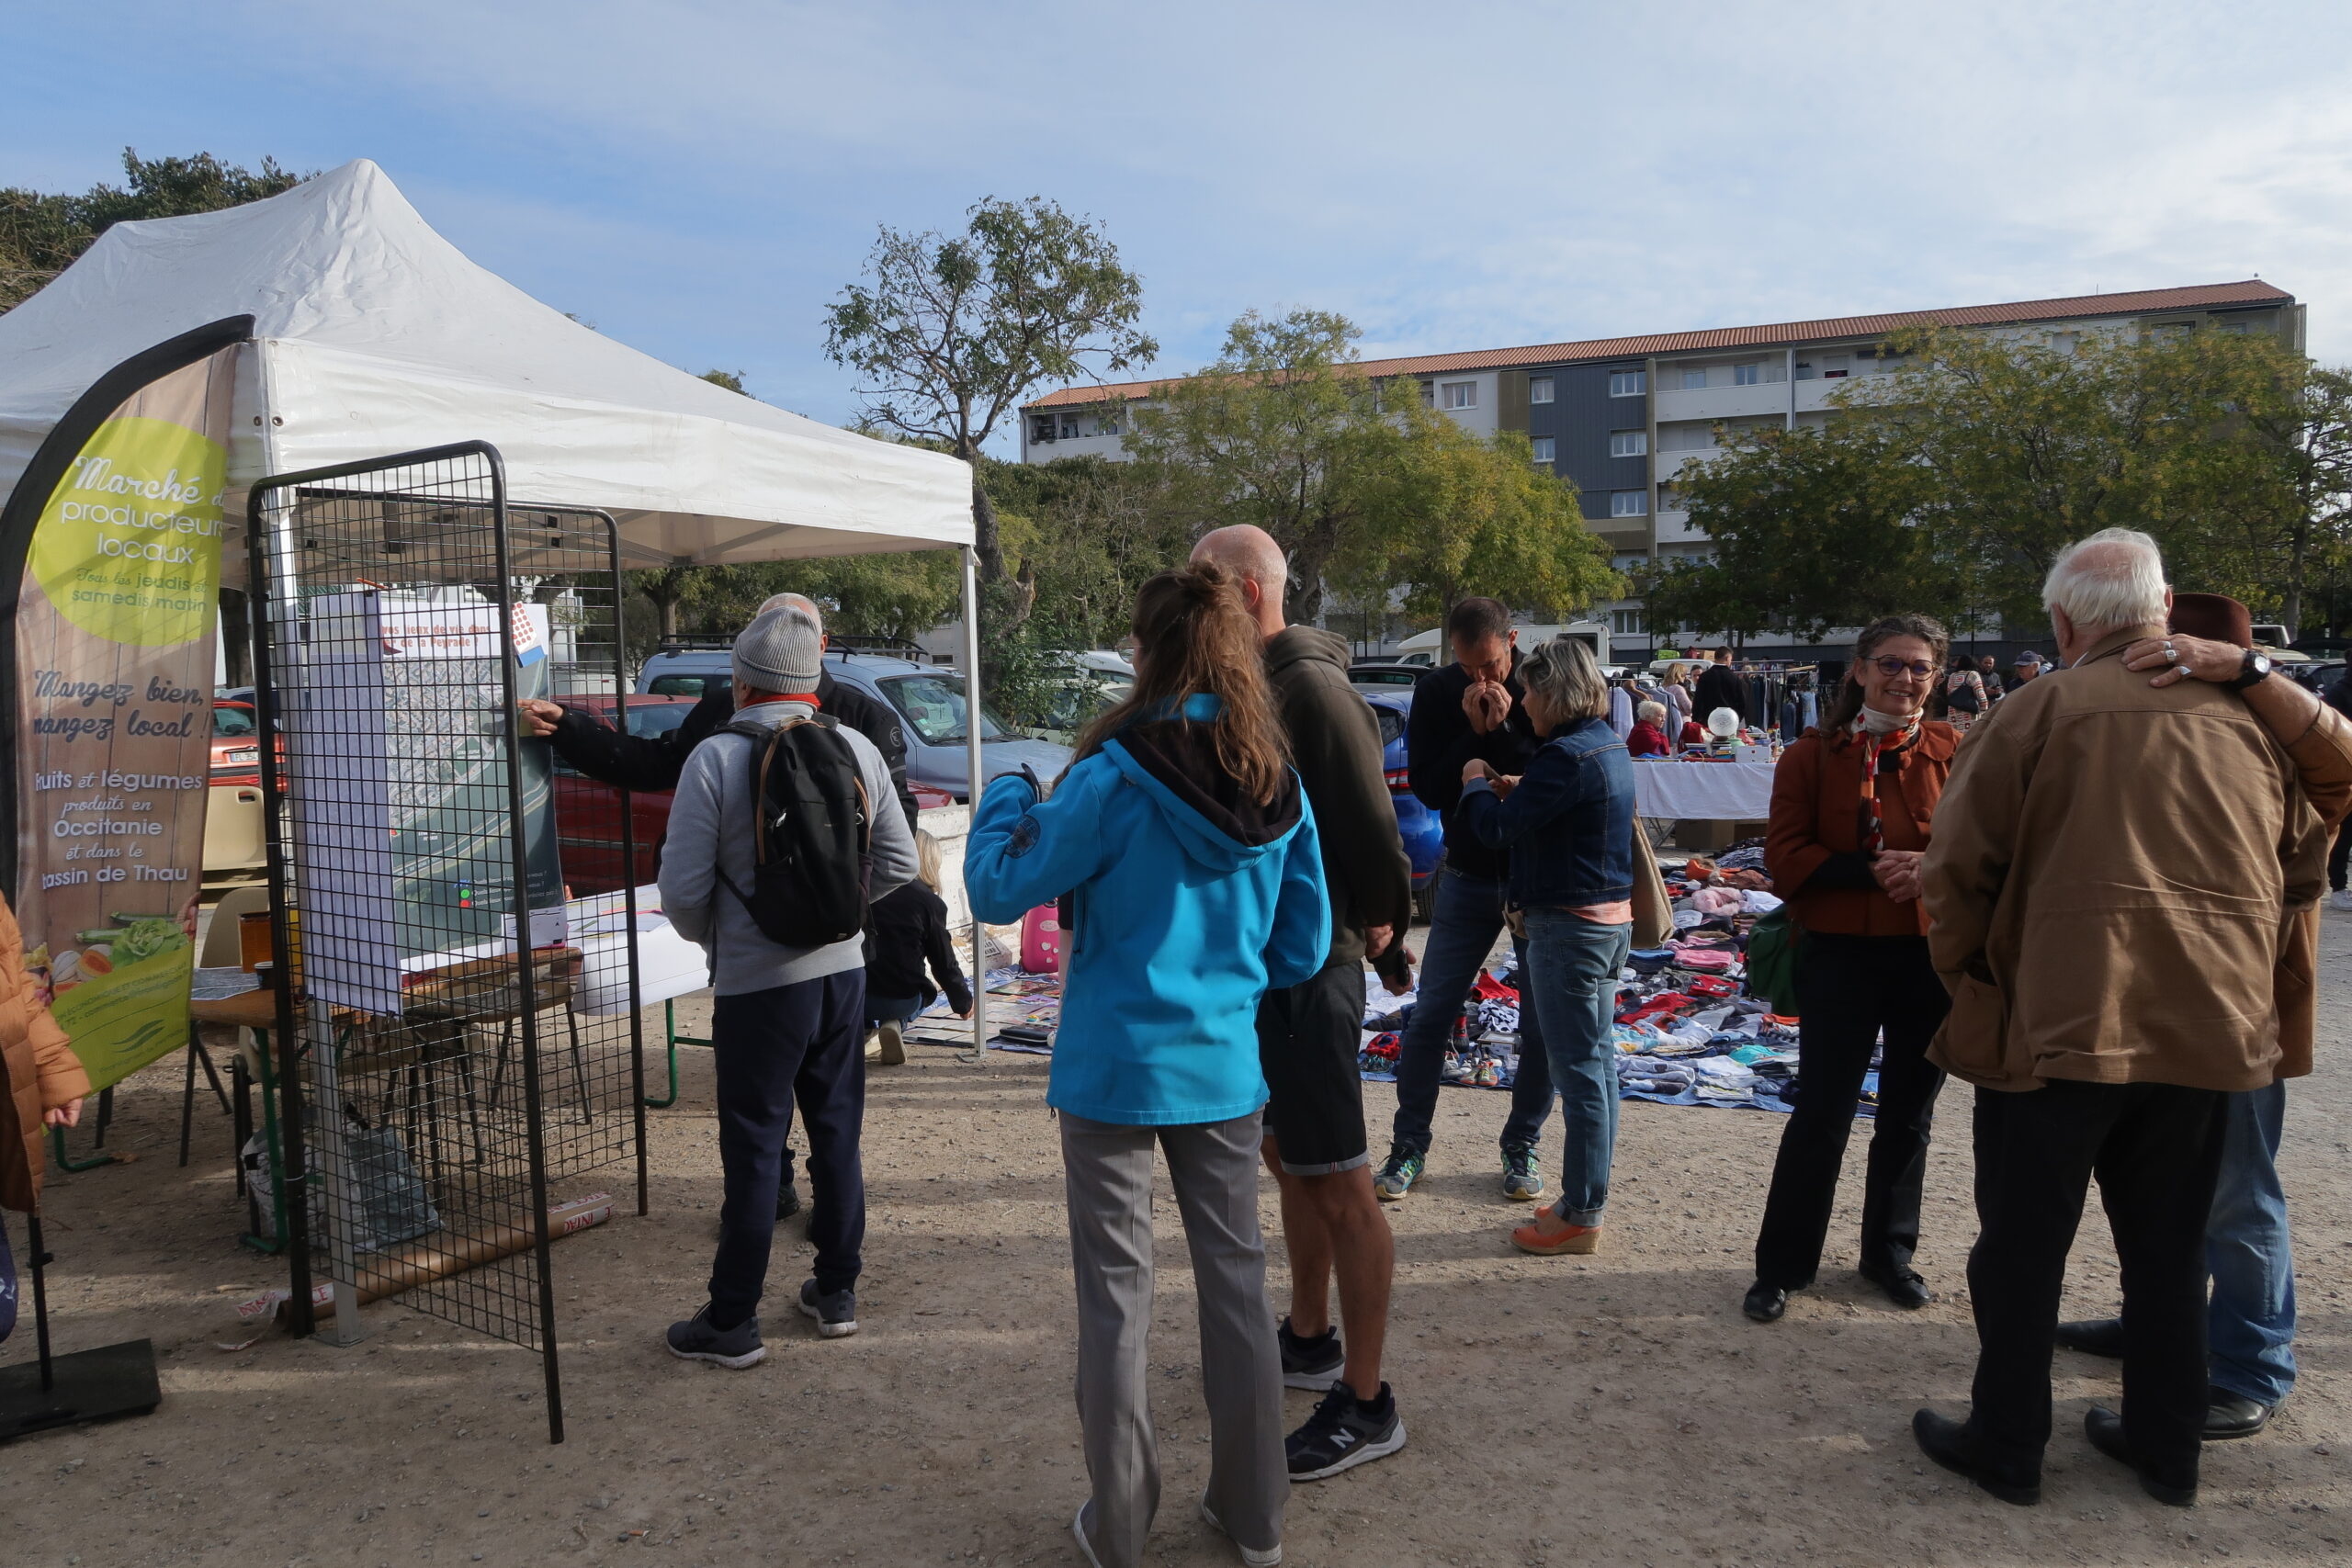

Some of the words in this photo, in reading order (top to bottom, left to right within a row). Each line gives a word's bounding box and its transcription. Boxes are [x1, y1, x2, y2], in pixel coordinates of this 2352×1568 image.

[74, 456, 204, 504] Marché
[211, 488, 224, 506] d
[97, 533, 195, 565] locaux
[75, 567, 107, 583] Tous
[114, 572, 131, 585] les
[137, 573, 190, 591] jeudis
[194, 579, 209, 593] et
[71, 589, 150, 607] samedis
[155, 597, 207, 612] matin
[433, 625, 446, 634] de
[34, 671, 134, 707] Mangez
[146, 676, 203, 705] bien,
[128, 709, 194, 738] local
[77, 772, 99, 788] et
[101, 769, 203, 793] légumes
[61, 795, 125, 818] produits
[131, 800, 153, 812] en
[53, 818, 163, 838] Occitanie
[65, 842, 85, 861] et
[85, 842, 122, 859] dans
[129, 841, 144, 858] le
[96, 864, 127, 882] de
[133, 864, 188, 882] Thau
